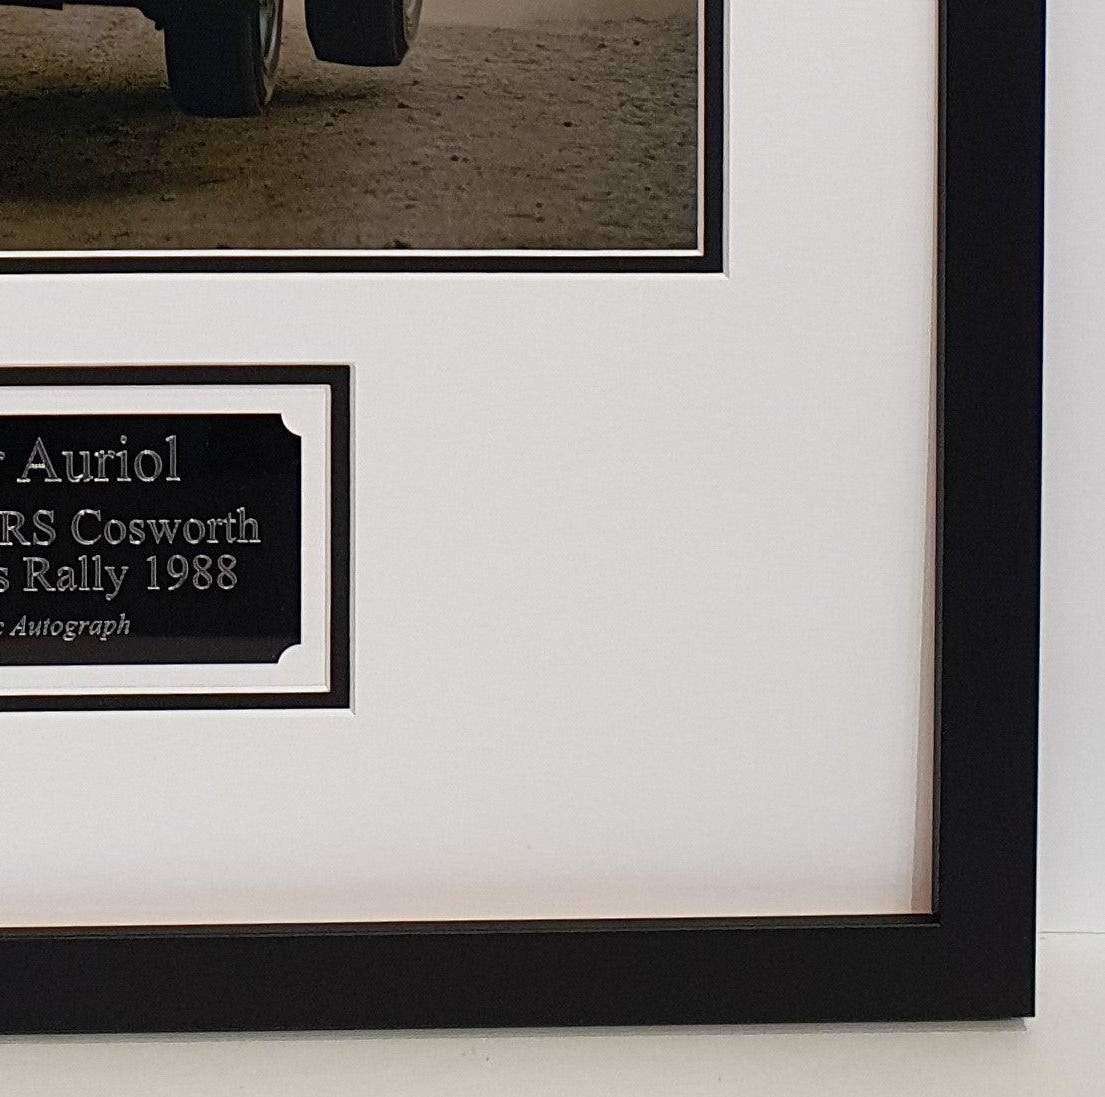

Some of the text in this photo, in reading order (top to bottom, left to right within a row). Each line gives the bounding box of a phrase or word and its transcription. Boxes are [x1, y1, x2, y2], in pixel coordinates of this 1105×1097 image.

[15, 434, 181, 484] Auriol
[71, 507, 262, 546] Cosworth
[22, 555, 130, 602] Rally
[146, 554, 238, 591] 1988
[8, 612, 131, 642] Autograph
